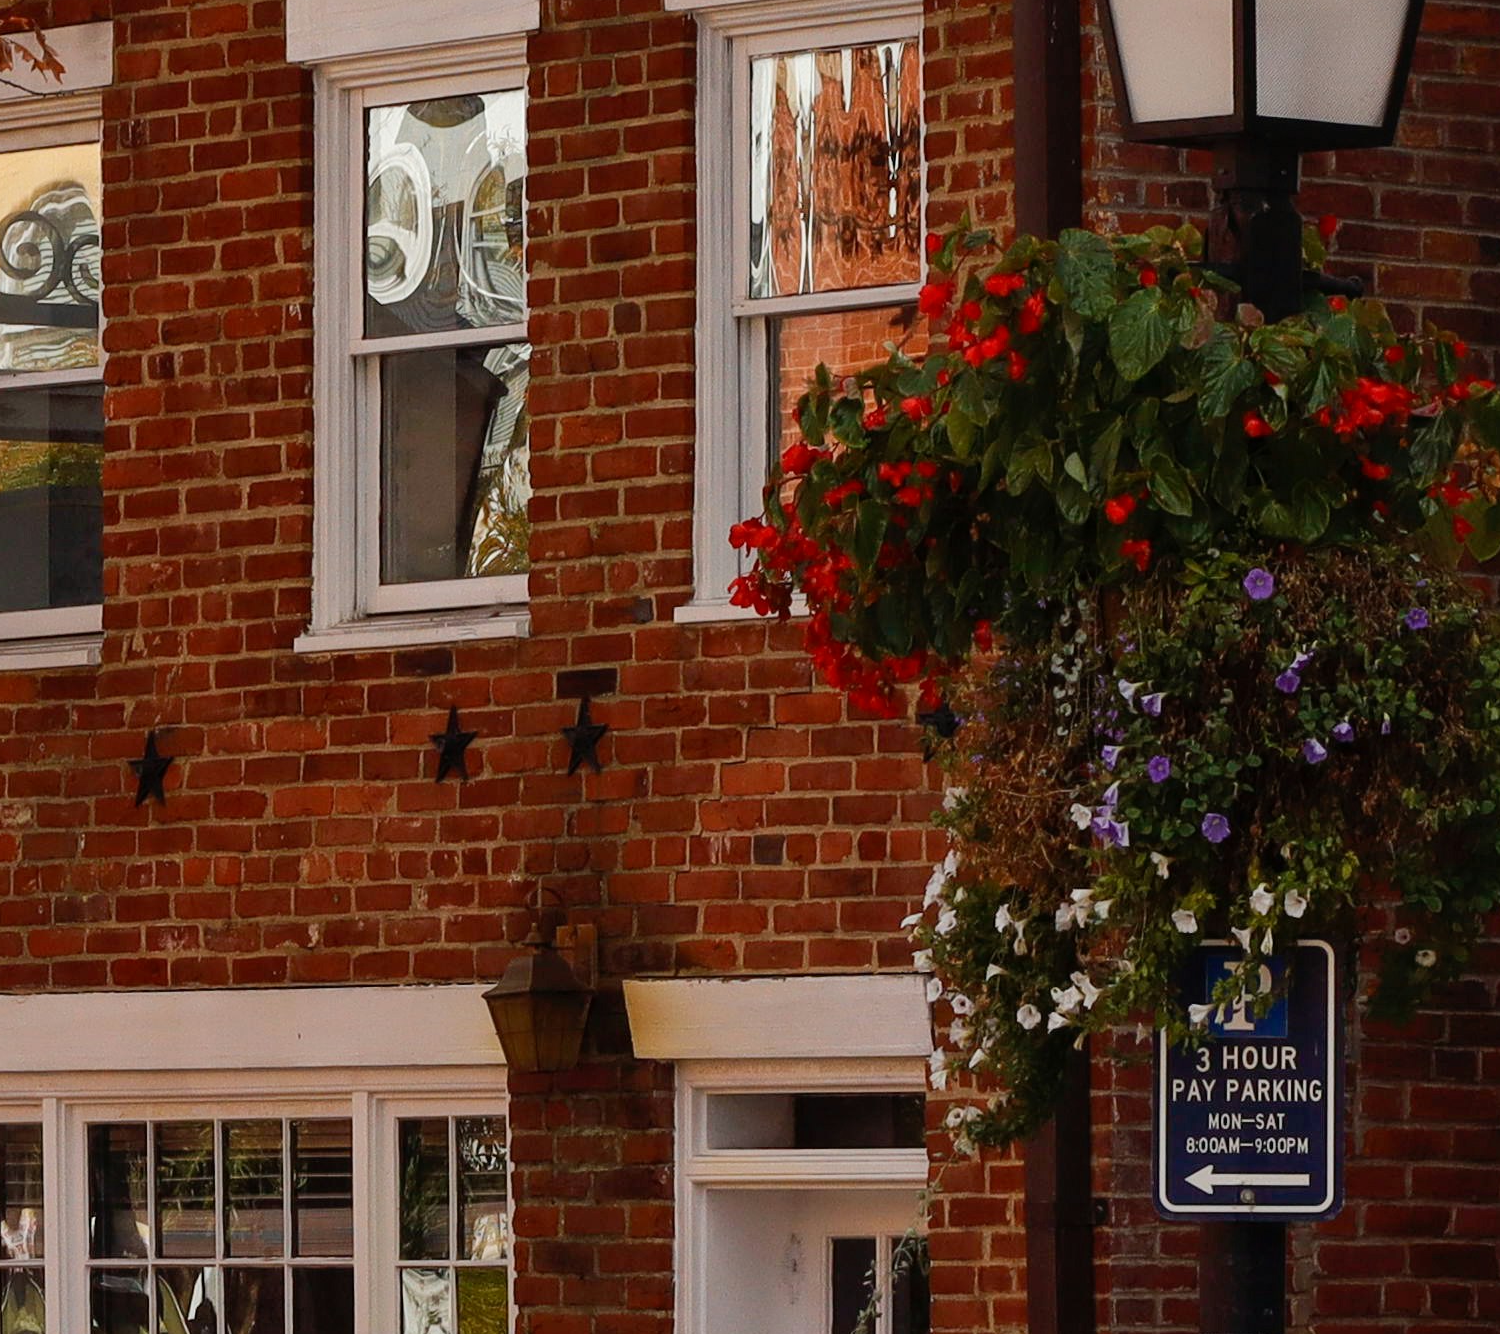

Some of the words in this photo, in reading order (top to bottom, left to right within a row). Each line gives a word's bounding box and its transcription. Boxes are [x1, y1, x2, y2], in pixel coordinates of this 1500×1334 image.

[1196, 1048, 1210, 1072] 3
[1222, 1046, 1297, 1070] HOUR
[1172, 1079, 1216, 1102] PAY
[1226, 1079, 1323, 1102] PARKING
